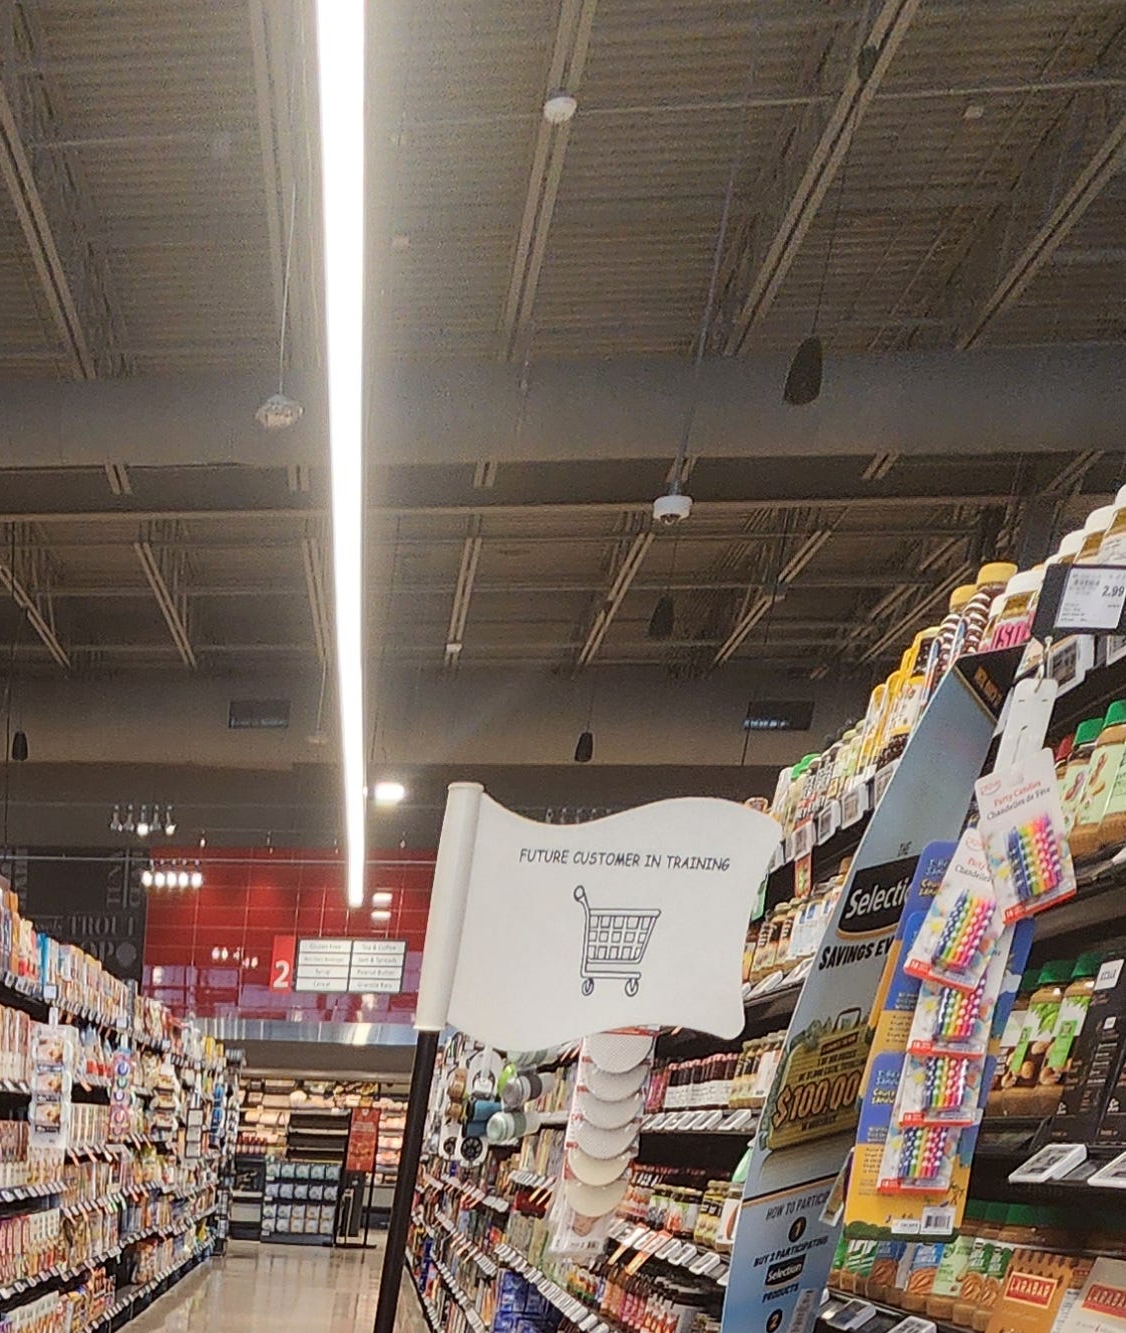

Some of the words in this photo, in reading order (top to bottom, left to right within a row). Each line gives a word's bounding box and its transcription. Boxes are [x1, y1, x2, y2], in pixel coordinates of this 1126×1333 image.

[1100, 585, 1125, 599] 2.99
[520, 848, 569, 865] FUTURE
[573, 851, 640, 868] CUSTOMER
[645, 853, 661, 869] IN
[666, 855, 730, 872] TRAINING
[818, 942, 874, 970] SAVINGS
[275, 960, 290, 988] 2
[766, 1206, 785, 1220] HOW
[785, 1203, 797, 1216] TO
[754, 1253, 769, 1267] BUY
[775, 1236, 829, 1261] PARTICIPATING
[767, 1261, 803, 1283] Selection
[762, 1284, 799, 1304] PRODUCTS
[1009, 1276, 1051, 1299] LARABAR
